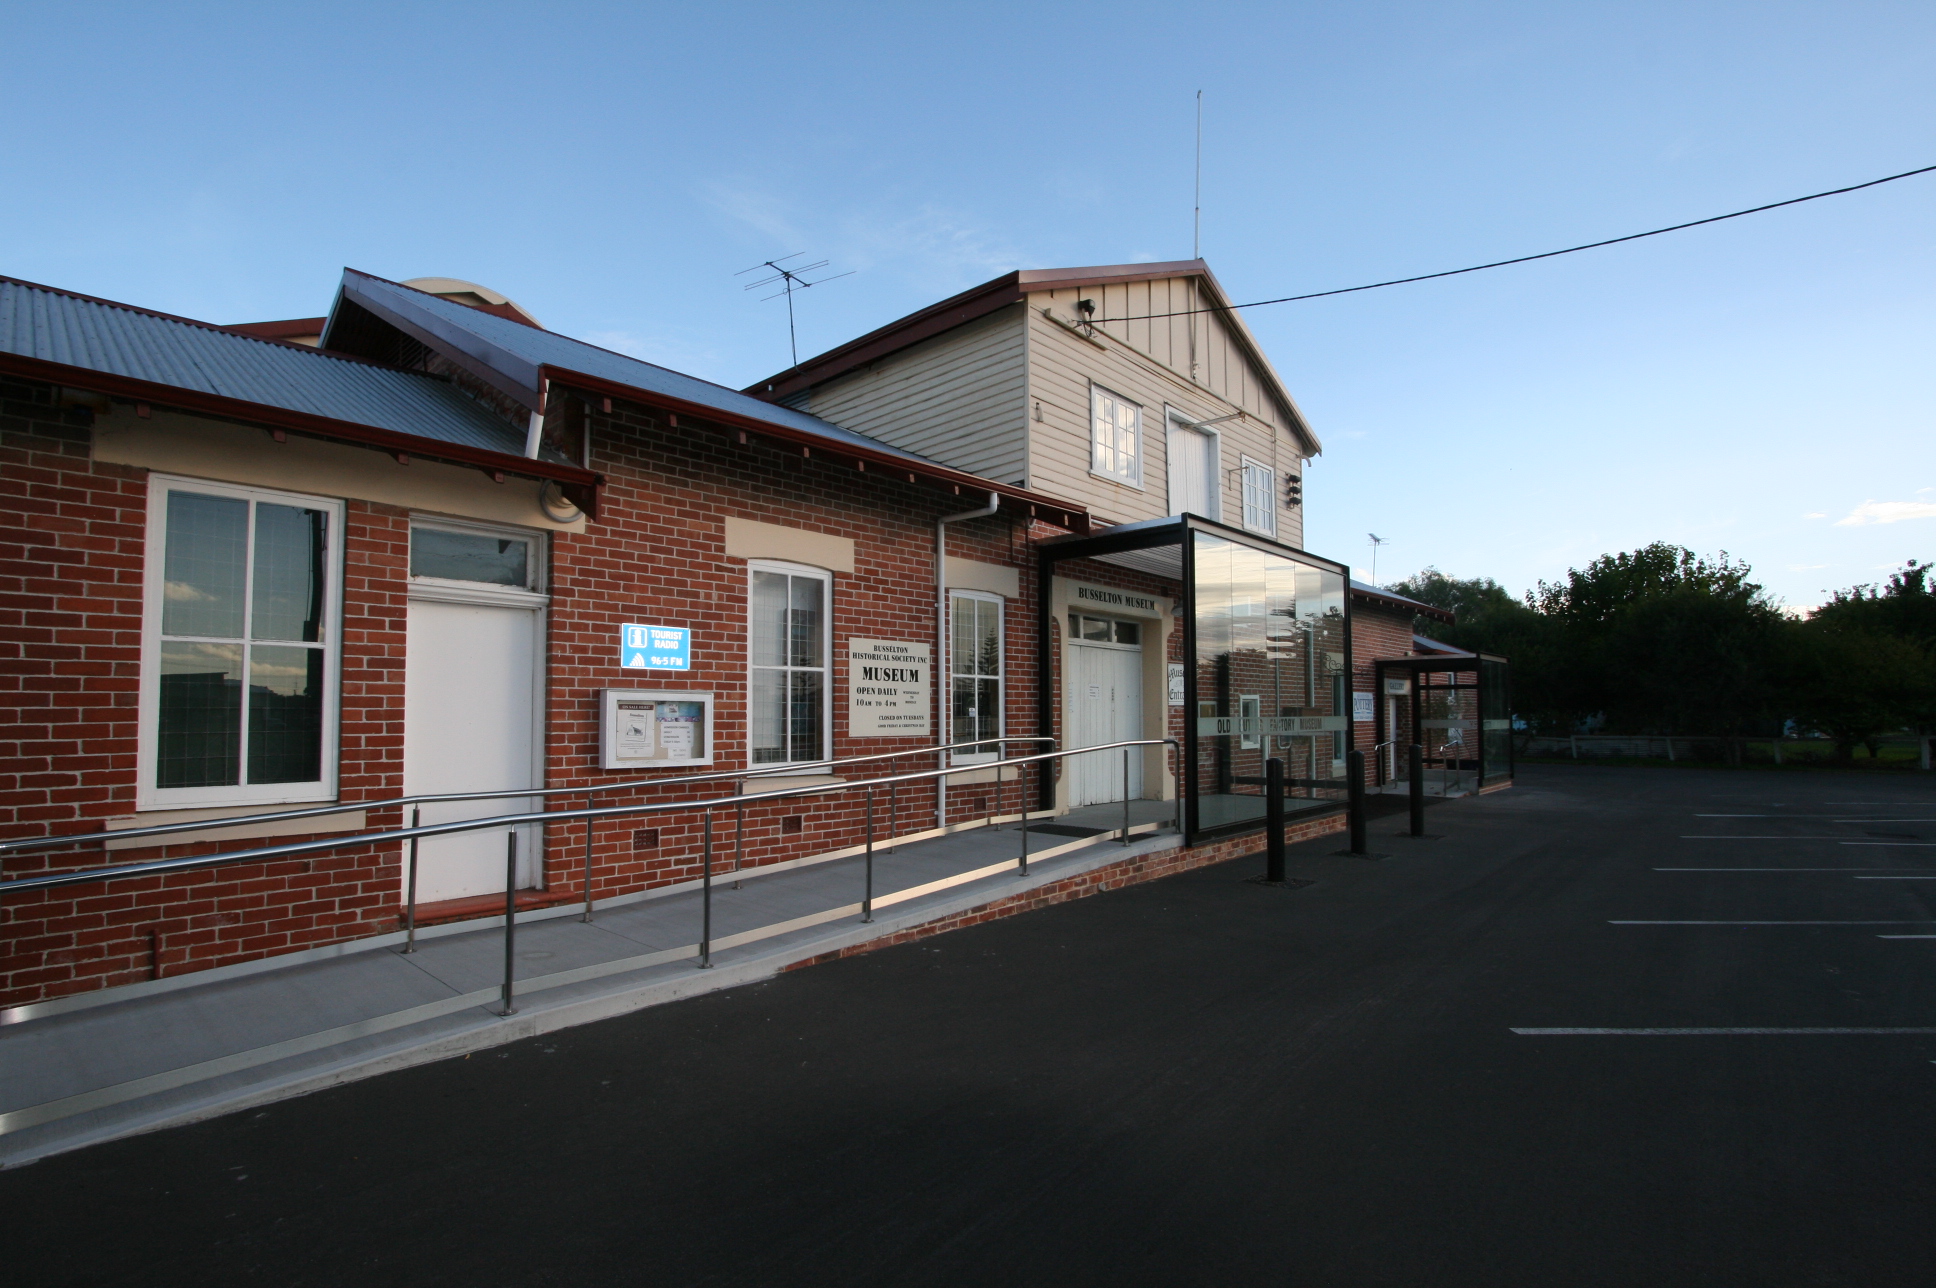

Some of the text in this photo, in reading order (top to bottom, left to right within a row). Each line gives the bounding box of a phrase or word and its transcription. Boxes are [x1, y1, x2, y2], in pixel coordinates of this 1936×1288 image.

[1078, 587, 1155, 610] BUSSELTON MUSEUM
[651, 629, 683, 640] TOURIST
[654, 640, 679, 650] RADIO
[873, 645, 908, 653] BUSSELTON
[670, 657, 683, 666] FM
[852, 652, 927, 664] HISTORICAL SOCIETY INC
[862, 666, 919, 683] MUSEUM
[856, 687, 897, 696] OPEN DAILY
[1218, 718, 1231, 734] OLD
[1300, 718, 1322, 730] MUSEUM
